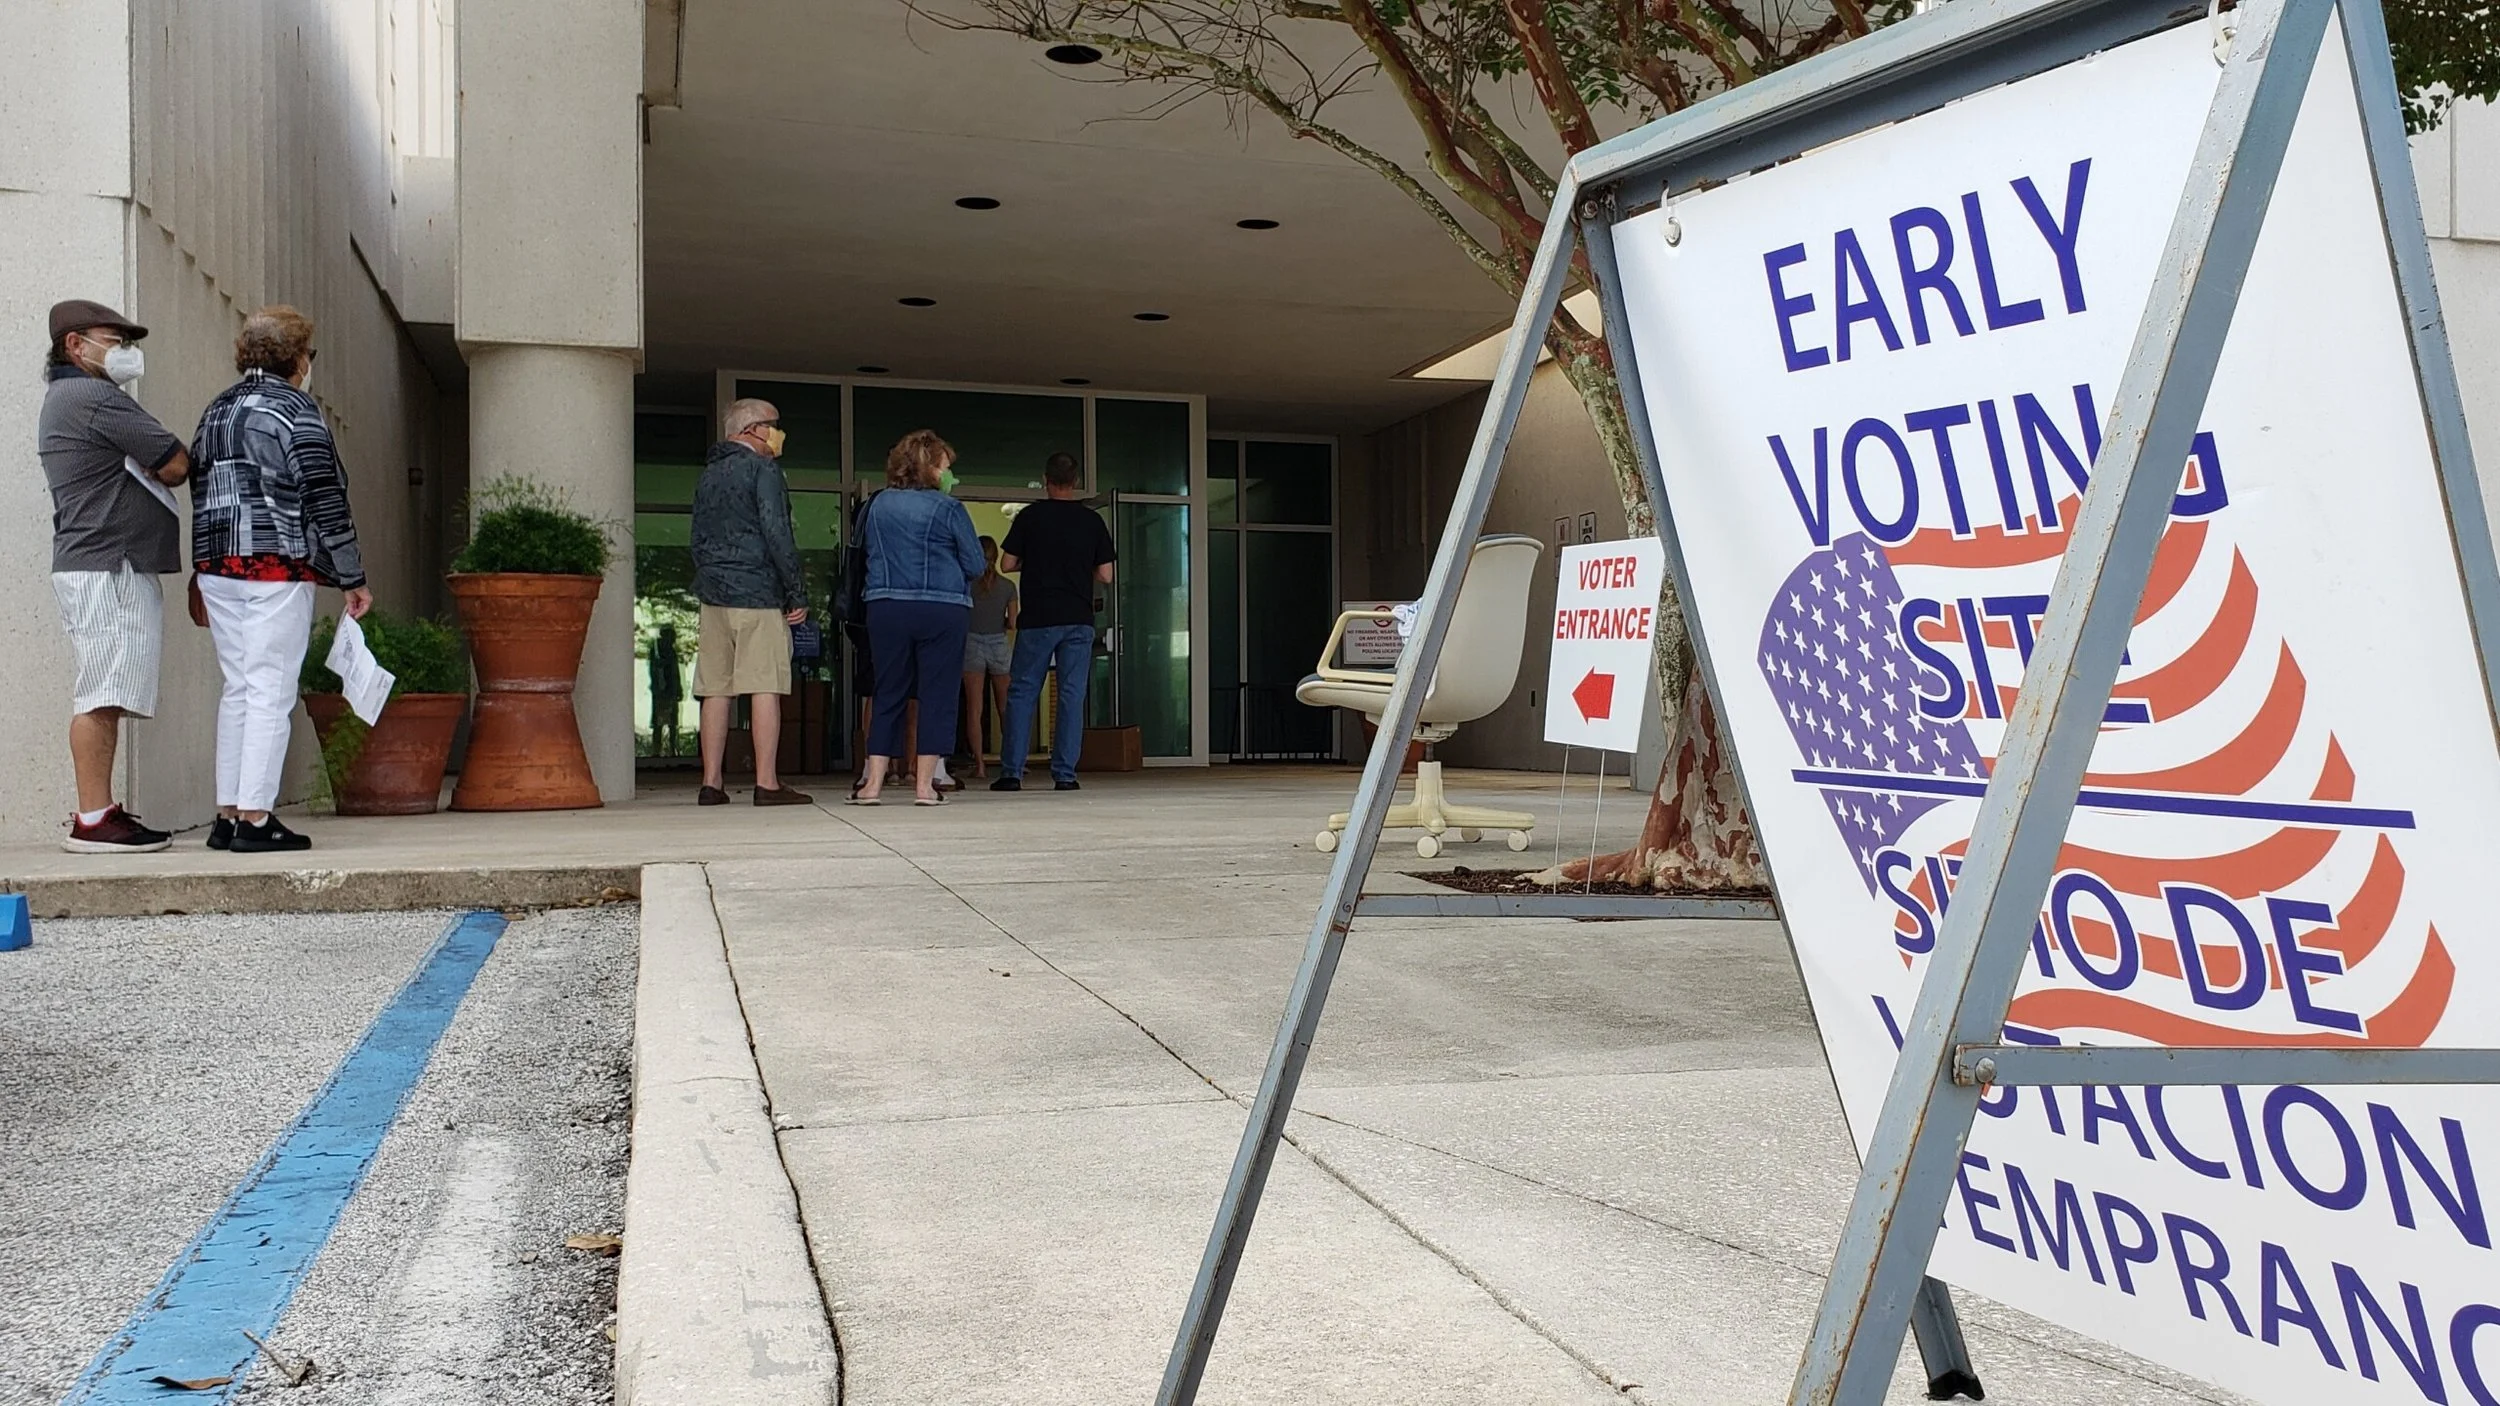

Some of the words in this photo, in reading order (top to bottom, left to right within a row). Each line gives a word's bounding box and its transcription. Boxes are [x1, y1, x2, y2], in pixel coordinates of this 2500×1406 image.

[1763, 157, 2092, 372] EARLY
[1556, 607, 1652, 640] ENTRANCE
[1579, 556, 1637, 590] VOTER
[1900, 594, 2151, 723] SIT
[2166, 887, 2363, 1033] DE
[1939, 1150, 2500, 1406] EMPRAN
